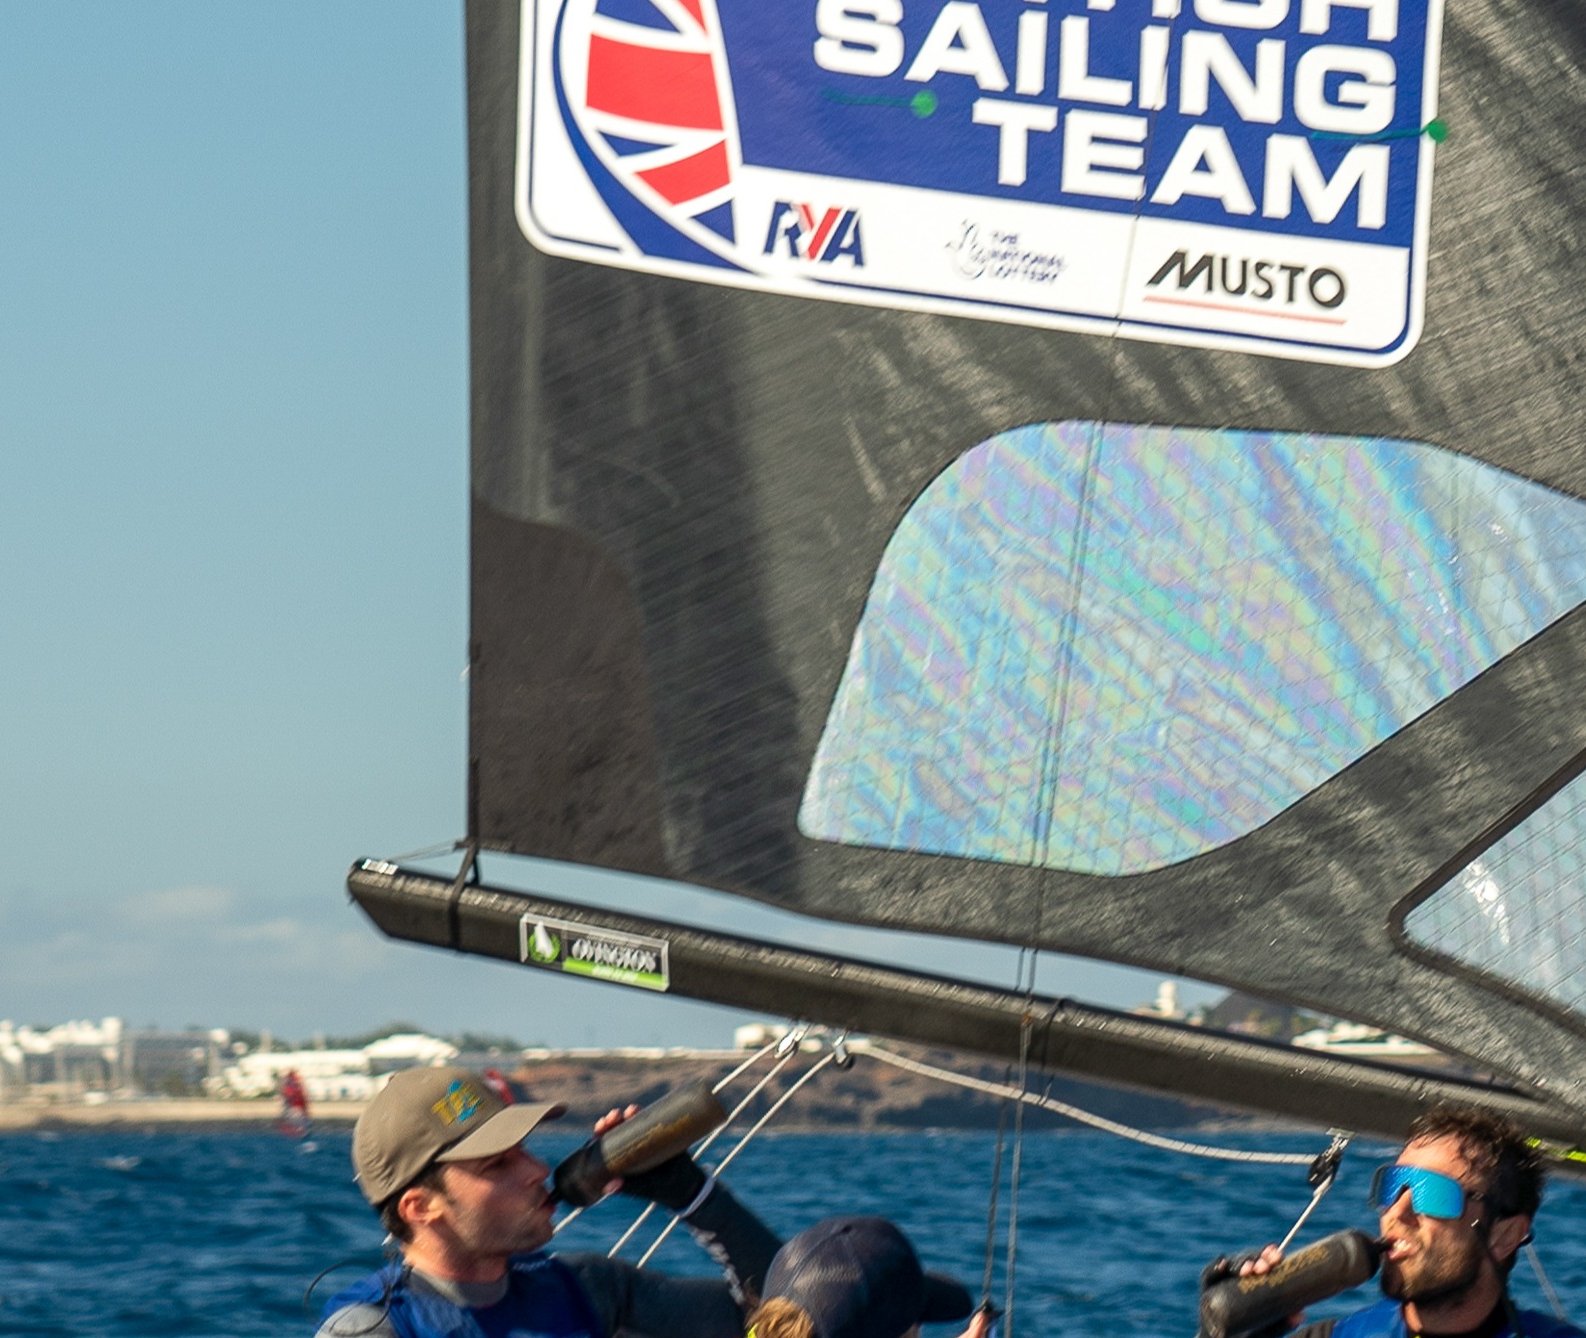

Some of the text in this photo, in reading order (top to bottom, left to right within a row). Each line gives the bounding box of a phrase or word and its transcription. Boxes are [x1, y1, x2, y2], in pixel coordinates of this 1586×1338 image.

[812, 0, 1397, 134] SAILING
[971, 97, 1391, 229] TEAM
[763, 199, 866, 267] RYA
[1145, 249, 1346, 308] MUSTO
